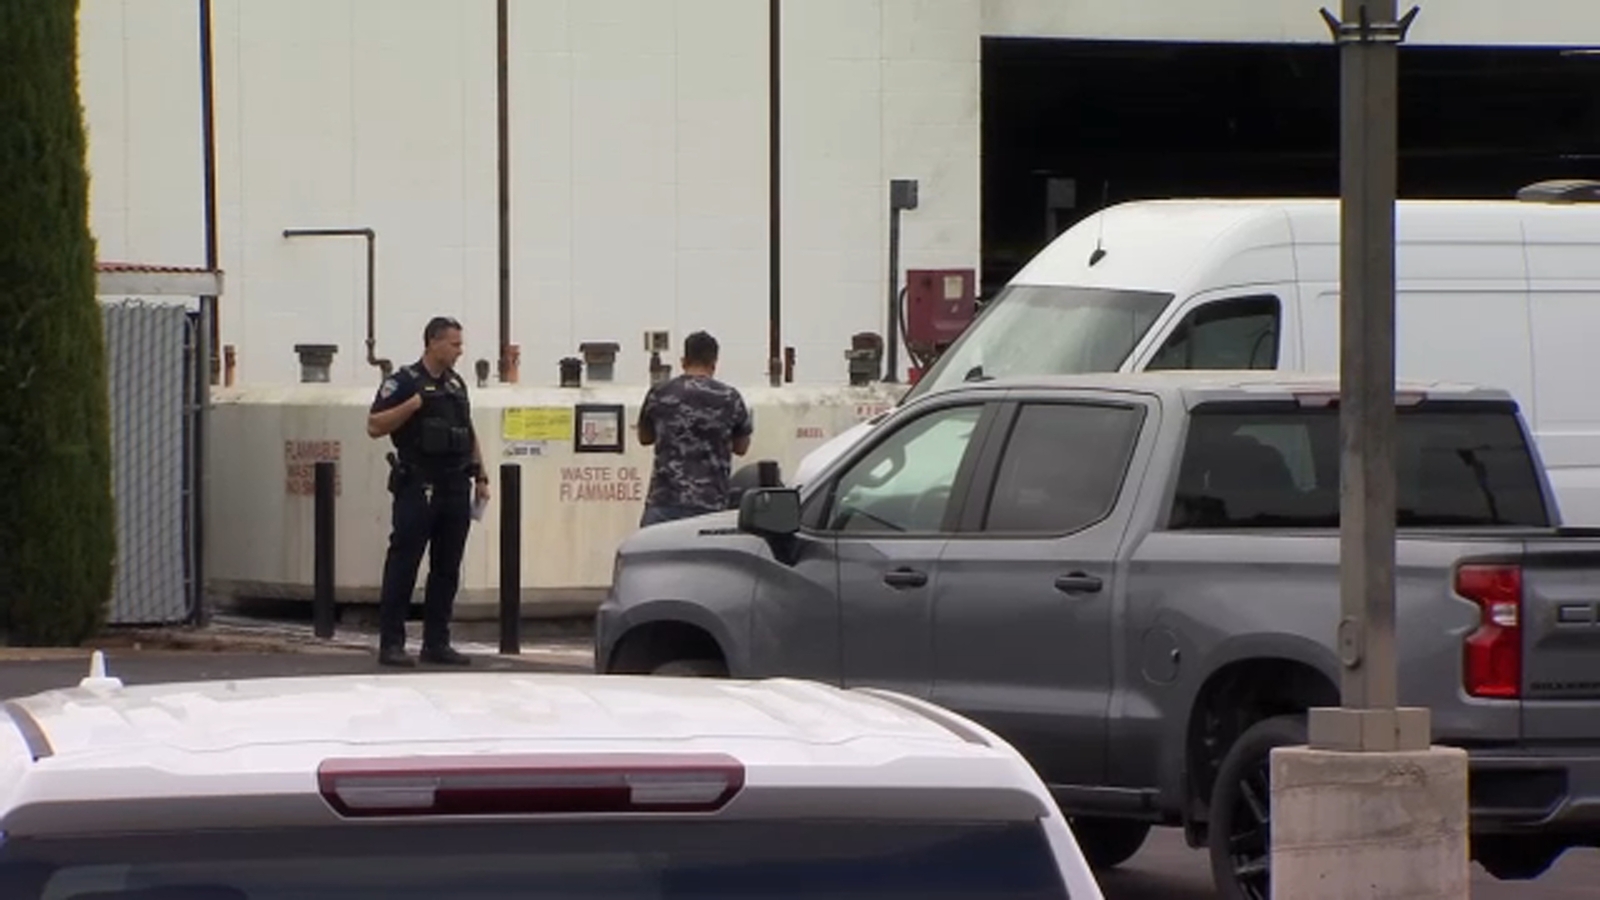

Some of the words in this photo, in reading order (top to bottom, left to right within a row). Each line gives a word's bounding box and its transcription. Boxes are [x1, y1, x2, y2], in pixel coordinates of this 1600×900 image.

[560, 467, 612, 481] WASTE
[617, 467, 642, 481] OIL
[560, 482, 643, 501] FLAMMABLE
